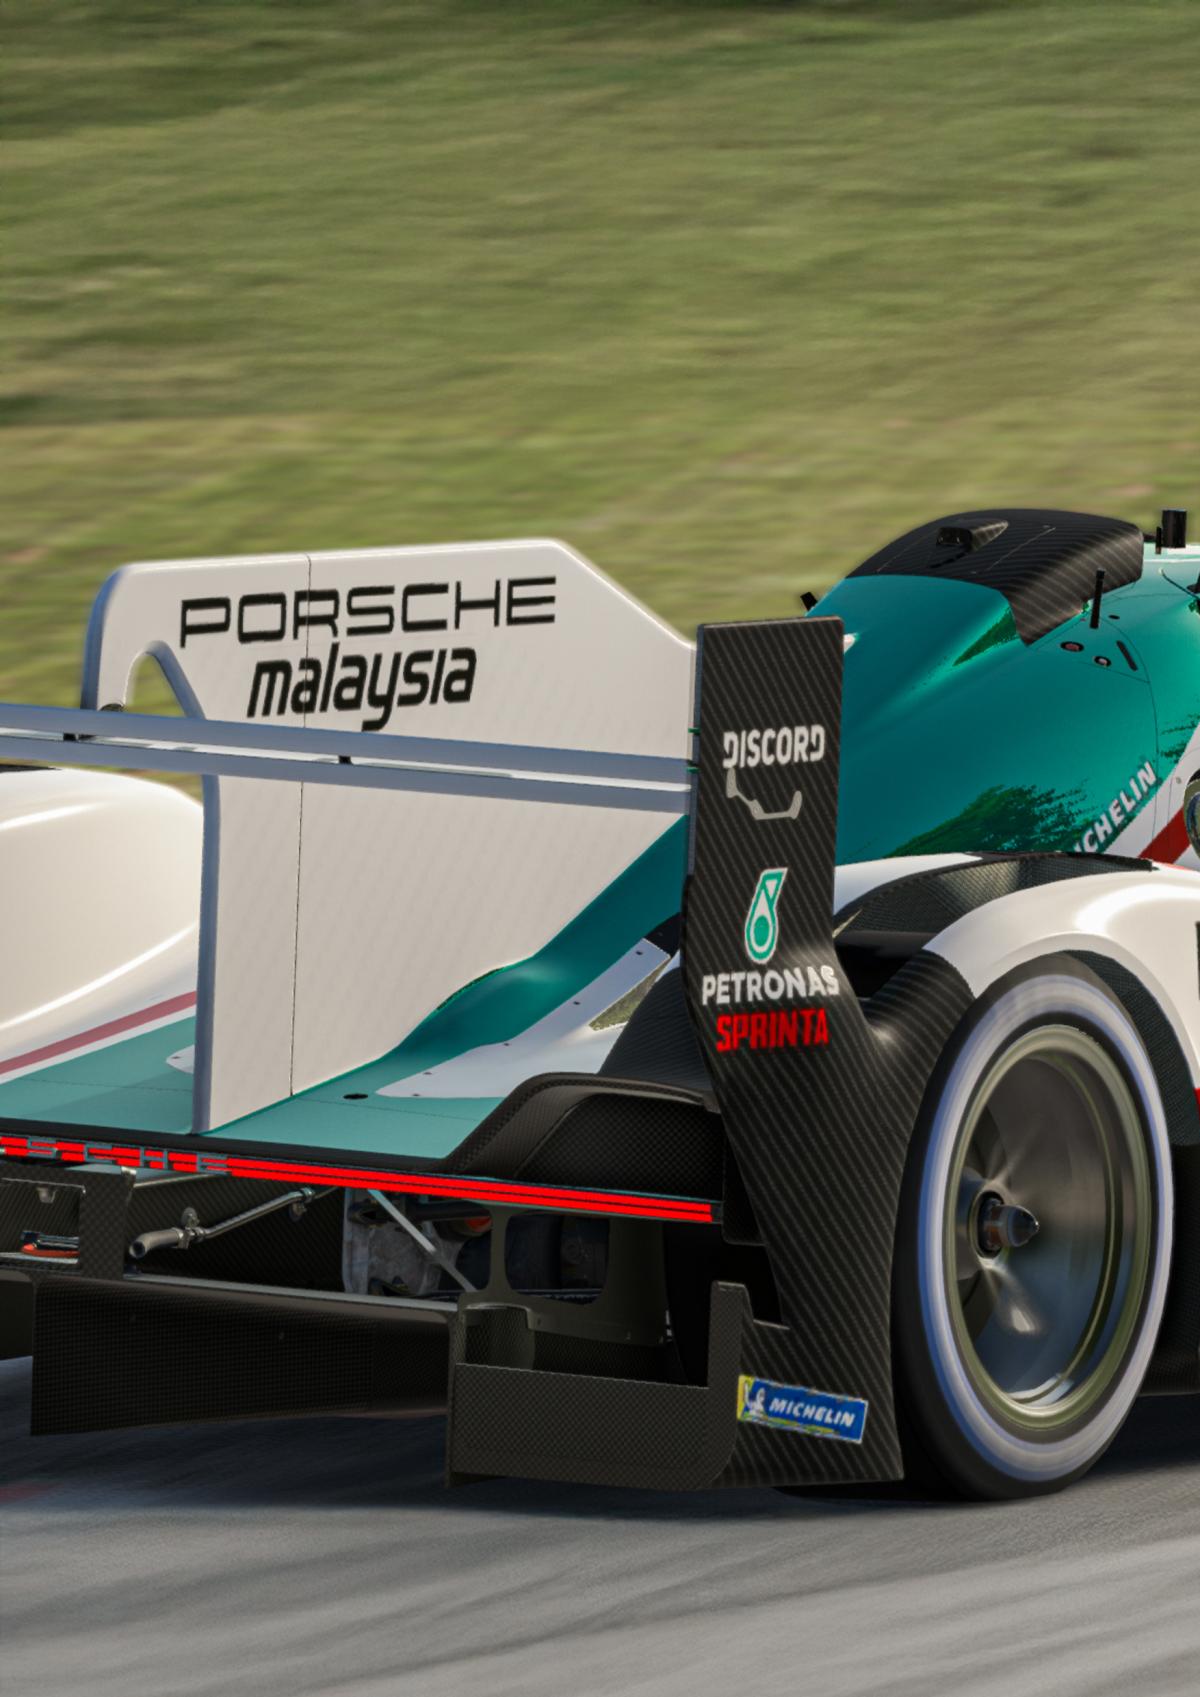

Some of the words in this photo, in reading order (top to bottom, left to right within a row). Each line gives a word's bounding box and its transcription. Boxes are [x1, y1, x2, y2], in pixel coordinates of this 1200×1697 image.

[180, 575, 557, 649] PORSCHE
[246, 646, 477, 732] malaysia
[722, 724, 826, 769] DISCORD
[701, 964, 841, 1006] PETRONAS
[715, 1007, 830, 1052] SPRINTA
[769, 1397, 856, 1427] MICHELIN
